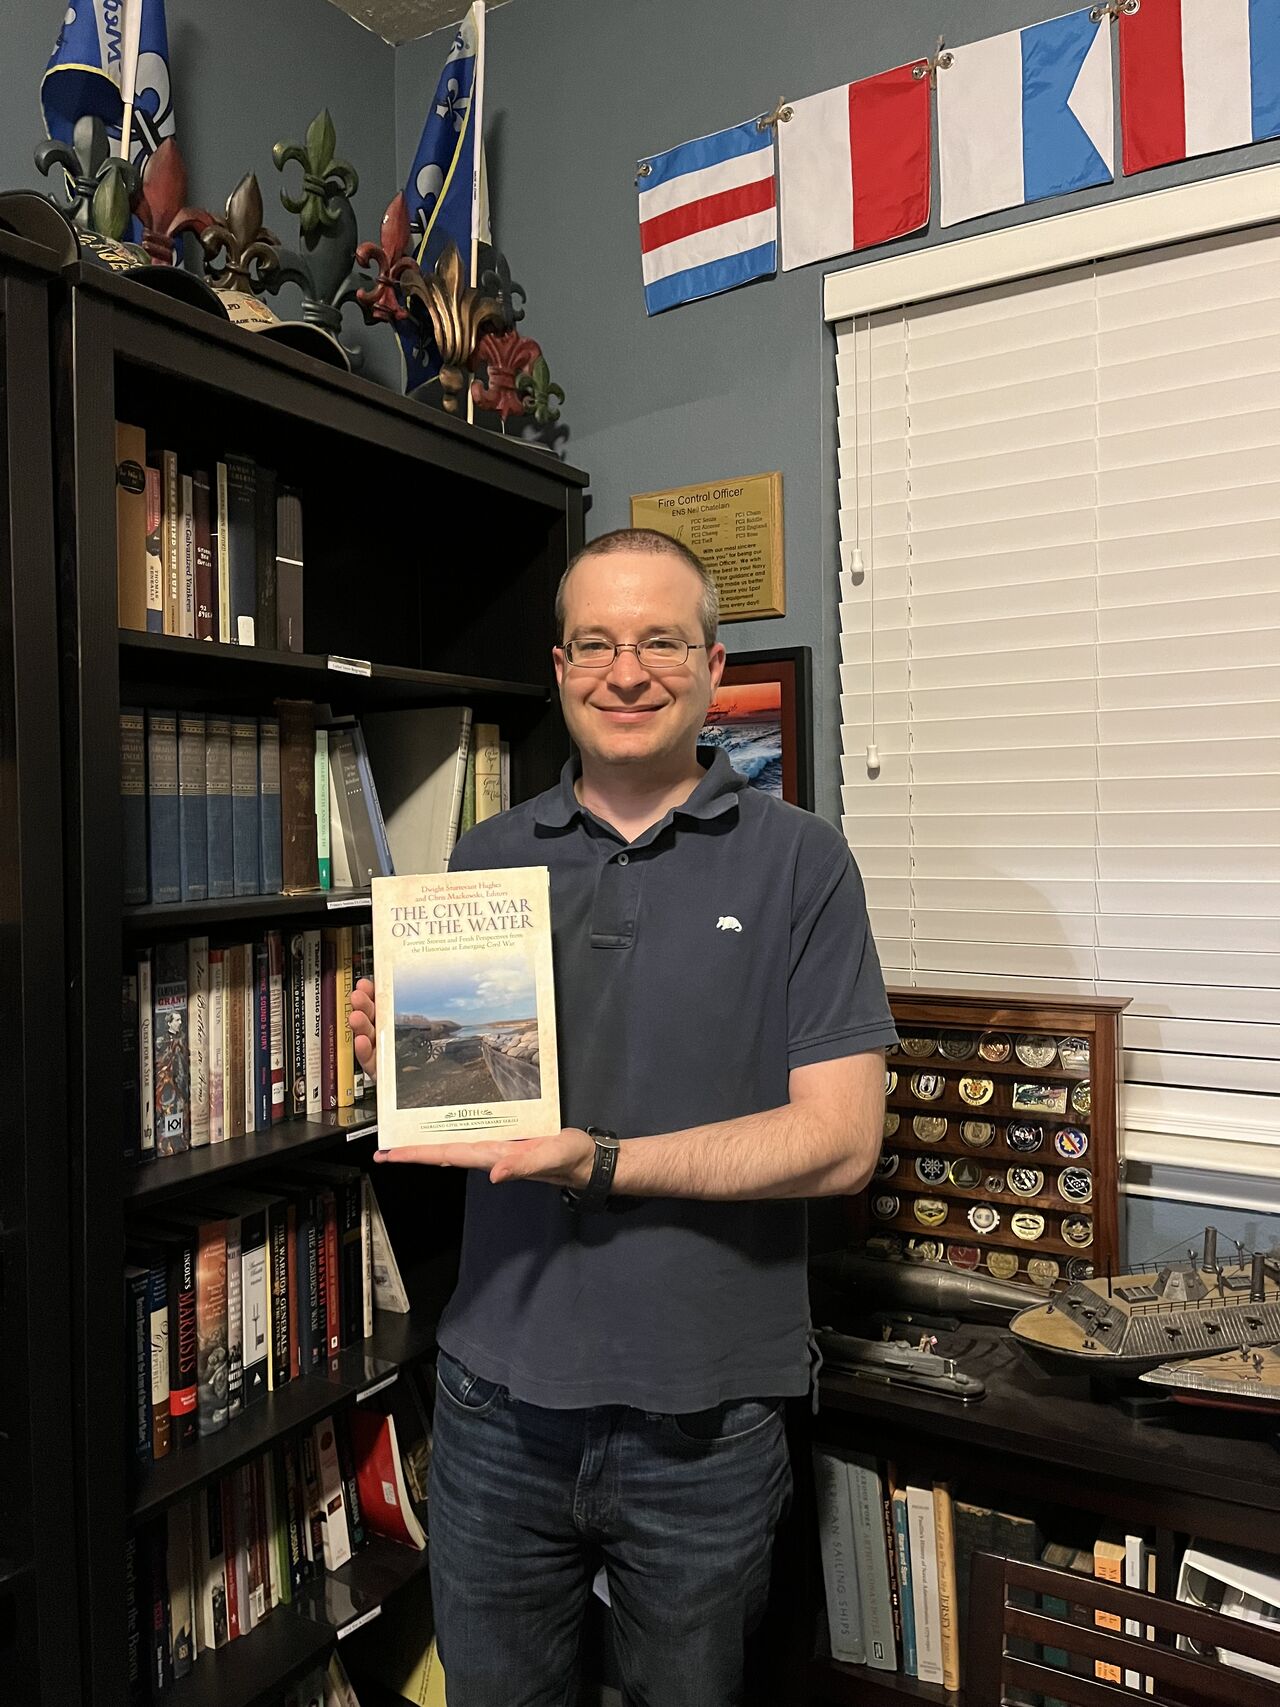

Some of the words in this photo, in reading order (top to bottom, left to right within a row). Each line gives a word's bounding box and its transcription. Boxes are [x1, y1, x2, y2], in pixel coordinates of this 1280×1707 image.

[658, 499, 675, 509] Fire
[678, 492, 711, 505] Control
[713, 488, 744, 500] Officer
[672, 508, 686, 517] ENS
[700, 502, 730, 513] Chatelain
[728, 572, 754, 580] guidance
[421, 886, 444, 894] Dwight
[478, 882, 502, 890] Hughes
[428, 894, 446, 902] Chris
[486, 890, 508, 898] Editors
[391, 906, 428, 922] THE
[433, 902, 483, 919] CIVIL
[488, 898, 533, 915] WAR
[392, 922, 420, 938] ON
[426, 919, 463, 935] THE
[468, 914, 534, 932] WATER
[422, 944, 450, 953] Historians
[458, 942, 486, 950] Emerging
[427, 938, 446, 946] Stories
[447, 936, 458, 944] and
[476, 934, 508, 942] Perspectives
[343, 957, 351, 998] FALLEN
[196, 994, 206, 1044] Brother
[260, 995, 268, 1022] SOUND
[142, 1018, 150, 1044] QUEST
[344, 1003, 352, 1044] LEAVES
[197, 1050, 204, 1065] in
[197, 1068, 206, 1102] Arms
[458, 1109, 480, 1118] 10TH
[308, 1227, 316, 1247] THE
[309, 1249, 318, 1307] PRESIDENTS'
[179, 1292, 196, 1374] MARXISTS
[138, 1422, 146, 1442] States
[826, 1462, 840, 1536] AMERICAN
[863, 1532, 874, 1570] ARTHUR
[898, 1533, 906, 1550] Stars
[834, 1542, 846, 1594] SAILING
[868, 1572, 878, 1606] CONAN
[128, 1606, 138, 1632] the
[839, 1601, 850, 1636] SHIPS
[870, 1606, 880, 1637] DOYLE
[941, 1594, 950, 1631] JERSEY
